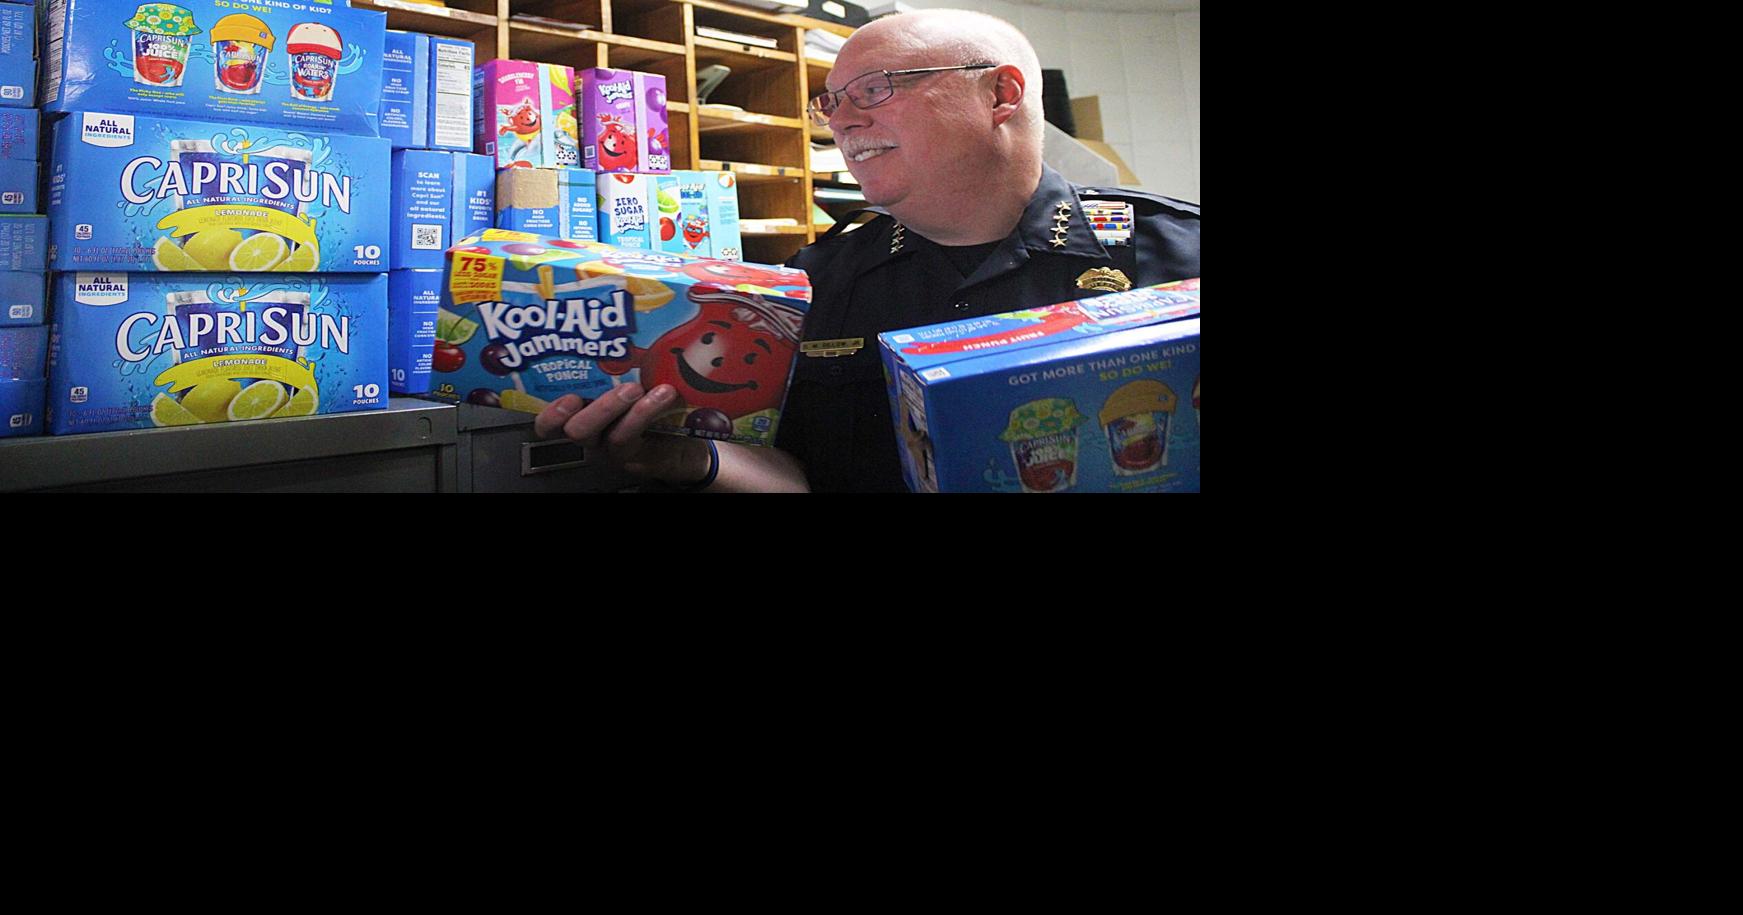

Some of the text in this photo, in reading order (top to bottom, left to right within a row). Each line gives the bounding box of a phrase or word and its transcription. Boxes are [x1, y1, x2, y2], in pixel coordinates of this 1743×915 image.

[215, 0, 272, 13] SO DO WE!
[265, 0, 290, 9] KIND
[309, 6, 332, 14] KID?
[140, 34, 184, 47] CAPRISUN
[142, 48, 178, 58] JUICE
[148, 43, 175, 51] 100%
[295, 55, 334, 67] CAPRISUN
[297, 68, 329, 79] WATERS
[100, 119, 118, 127] ALL
[85, 125, 131, 135] NATURAL
[121, 156, 350, 214] CAPRISUN
[244, 197, 295, 209] INGREDIENTS
[615, 197, 638, 206] ZERO
[214, 209, 268, 217] LEMONADE
[614, 205, 644, 216] SUGAR
[353, 245, 381, 259] 10
[478, 290, 627, 340] Kool-Aid
[116, 306, 349, 362] CAPRISUN
[963, 331, 1045, 351] FRUIT PUNCH
[201, 346, 238, 355] NATURAL
[242, 345, 293, 355] INGREDIENTS
[500, 333, 627, 367] Jammers
[213, 358, 267, 368] LEMONADE
[532, 359, 593, 375] TROPICAL
[1008, 344, 1196, 385] GOT MORE THAN ONE KIND
[391, 368, 405, 381] 10
[547, 370, 588, 382] PUNCH
[1100, 359, 1172, 381] SO DO WE!
[353, 383, 380, 398] 10
[440, 384, 454, 393] 10
